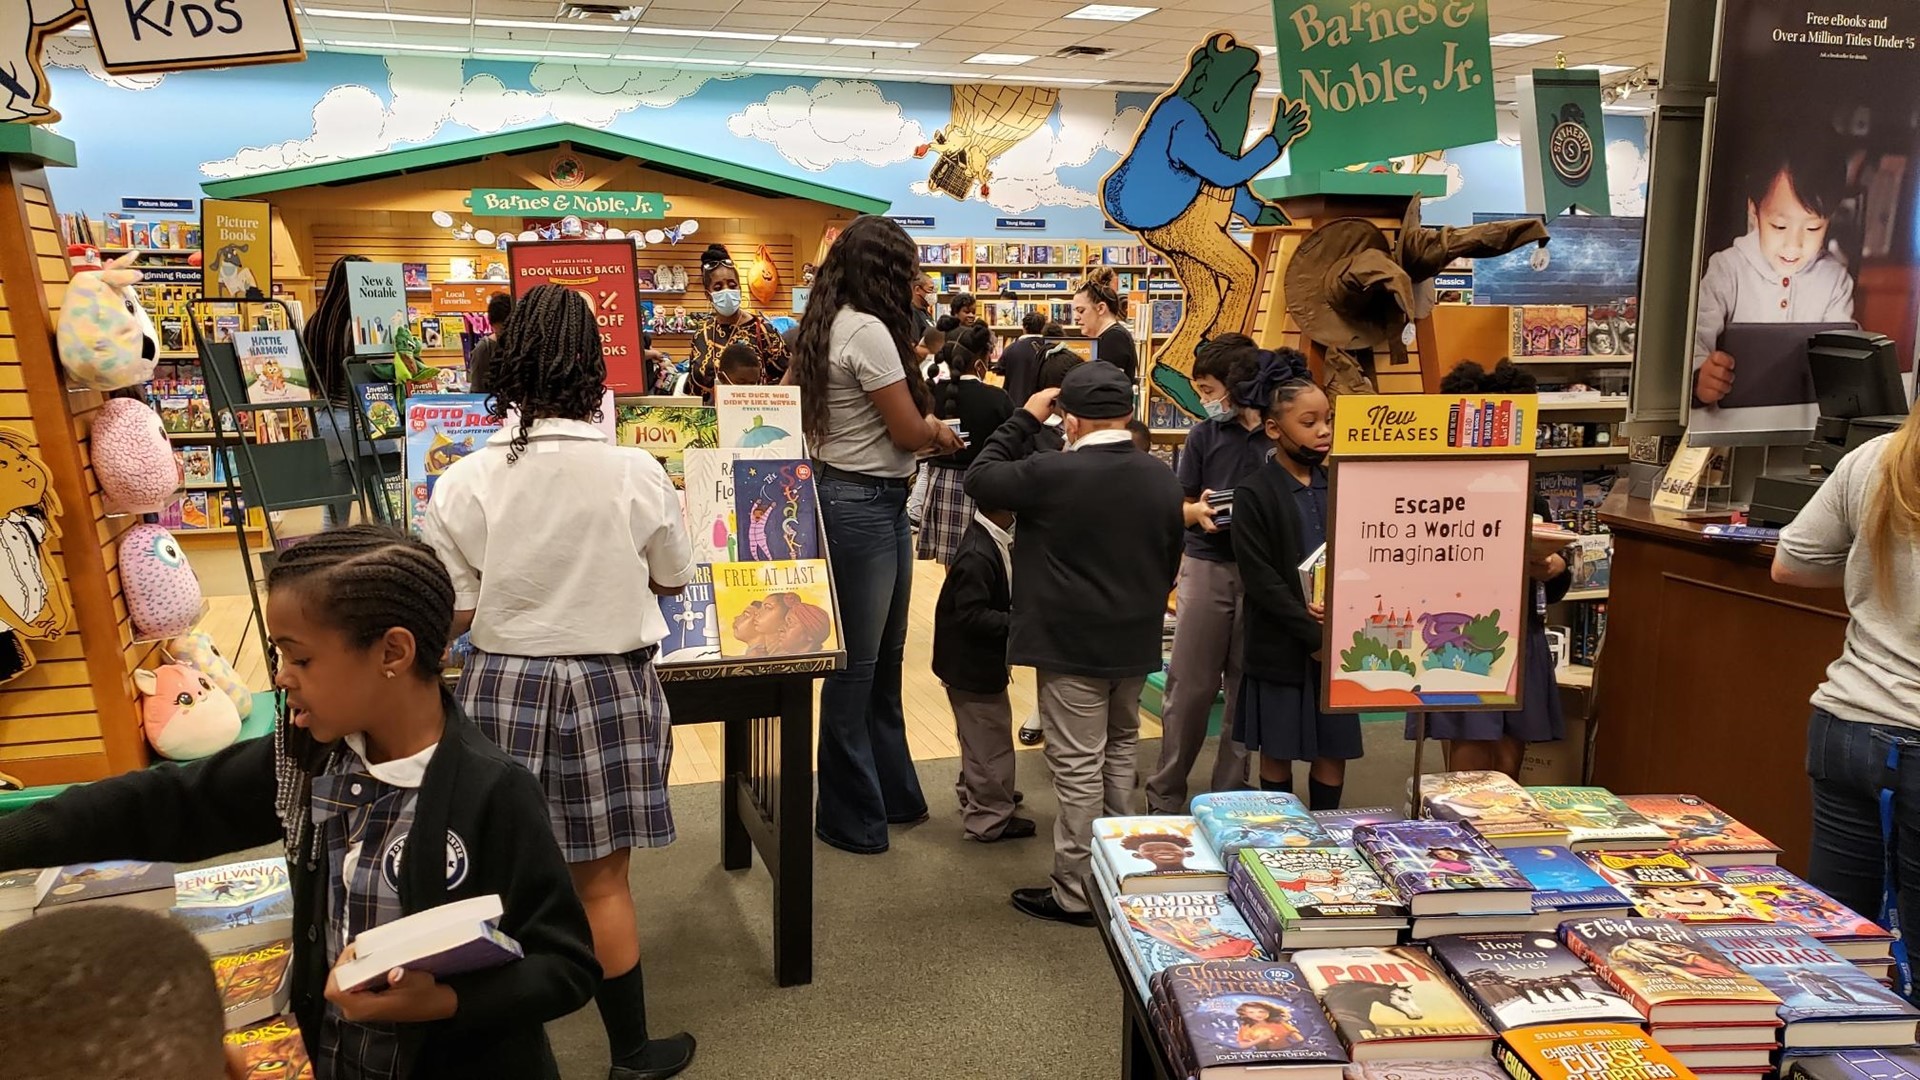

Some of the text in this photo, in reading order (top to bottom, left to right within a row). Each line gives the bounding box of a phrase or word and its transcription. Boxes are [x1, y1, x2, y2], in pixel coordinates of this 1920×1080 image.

[125, 0, 243, 41] KIDS
[1290, 0, 1475, 51] Barnes &
[1806, 12, 1888, 29] Free eBooks and
[1772, 28, 1798, 42] Over
[1799, 34, 1806, 43] a
[1808, 31, 1843, 45] Million
[1845, 33, 1872, 47] Titles
[1874, 35, 1905, 48] Under
[1298, 41, 1482, 112] Noble, Jr.
[1553, 126, 1590, 153] SLYTHERIN
[484, 193, 653, 215] Barnes & Noble, Jr.
[216, 215, 259, 229] Picture
[220, 229, 257, 242] Books
[521, 264, 626, 277] BOOK HAUL IS BACK!
[361, 275, 393, 286] New &
[1434, 277, 1465, 286] Classics
[359, 287, 397, 299] Notable
[440, 298, 472, 306] Favorites
[597, 314, 625, 326] OFF
[1367, 405, 1417, 429] New
[635, 426, 677, 444] HOM
[1348, 427, 1438, 442] RELEASES
[1395, 496, 1466, 514] Escape
[1361, 520, 1502, 539] into a World of
[1369, 545, 1484, 565] Imagination
[724, 566, 815, 587] FREE AT LAST
[1637, 873, 1690, 882] GAME
[1131, 893, 1217, 906] ALMOST
[1142, 904, 1219, 918] FLYING
[1575, 918, 1677, 939] Elephant
[1656, 931, 1696, 944] Girl
[1713, 937, 1775, 950] LINES
[1477, 940, 1523, 950] How
[1475, 949, 1549, 961] Do You
[1494, 959, 1549, 972] Live?
[1316, 961, 1431, 986] PONY
[1533, 1028, 1622, 1041] STUART GIBBS
[1215, 1050, 1328, 1061] JODI LYNN ANDERSON
[1540, 1038, 1651, 1060] CHARLIE THORNE
[1560, 1049, 1653, 1074] CURSE
